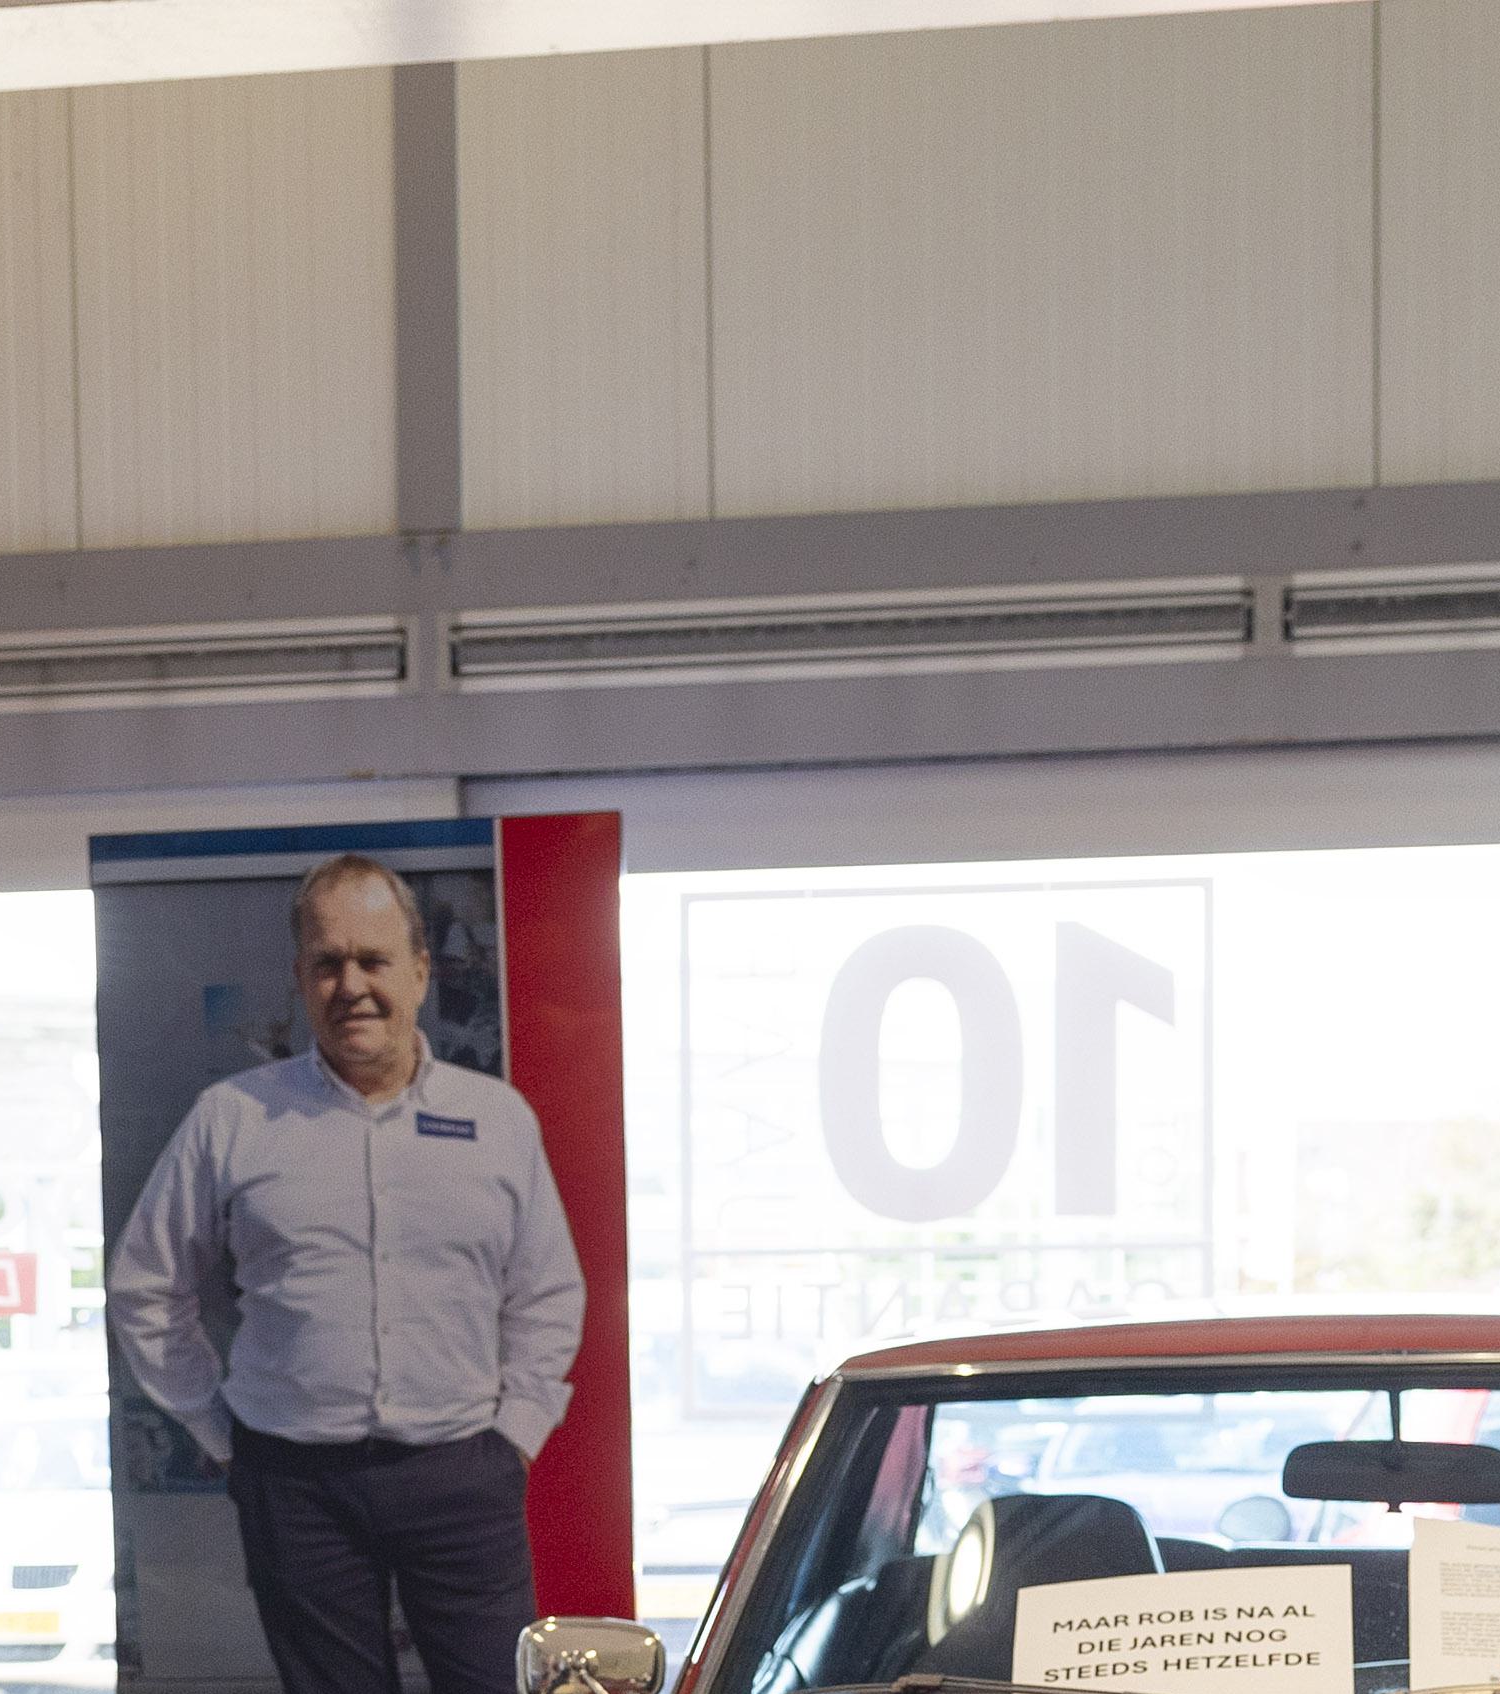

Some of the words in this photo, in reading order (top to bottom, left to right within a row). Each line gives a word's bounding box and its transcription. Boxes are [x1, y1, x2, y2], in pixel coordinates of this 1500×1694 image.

[1053, 1614, 1129, 1633] MAAR
[1138, 1610, 1194, 1626] ROB
[1204, 1607, 1227, 1621] IS
[1237, 1605, 1275, 1619] NA
[1282, 1604, 1316, 1618] AL
[1078, 1638, 1122, 1655] DIE
[1128, 1632, 1214, 1651] JAREN
[1225, 1629, 1287, 1644] NOG
[1044, 1660, 1148, 1683] STEEDS
[1162, 1652, 1321, 1673] HETZELFDE
